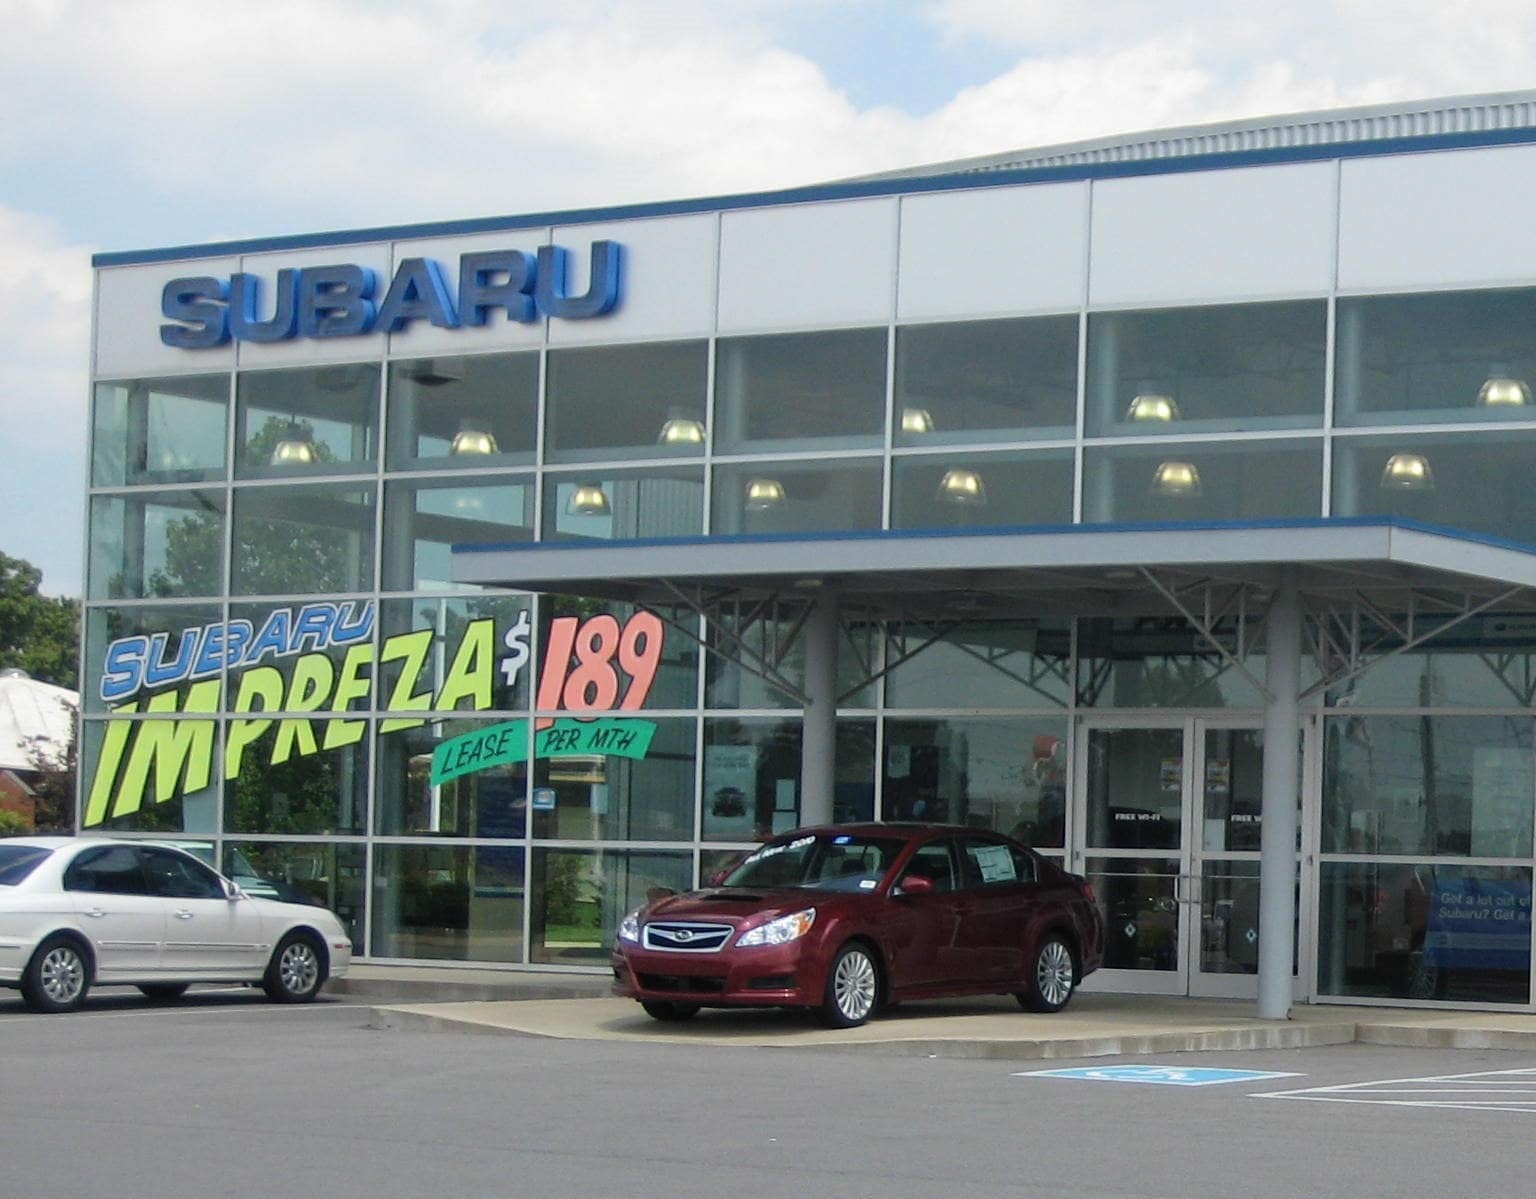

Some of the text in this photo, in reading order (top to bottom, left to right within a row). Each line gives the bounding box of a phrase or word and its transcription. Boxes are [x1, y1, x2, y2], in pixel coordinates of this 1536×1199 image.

[160, 240, 622, 348] SUBARU
[101, 602, 375, 700] SUBARU
[75, 618, 494, 828] IMPREZA
[440, 728, 635, 776] LEASE PER MTH
[1115, 813, 1136, 821] FREE
[1231, 814, 1252, 823] FREE
